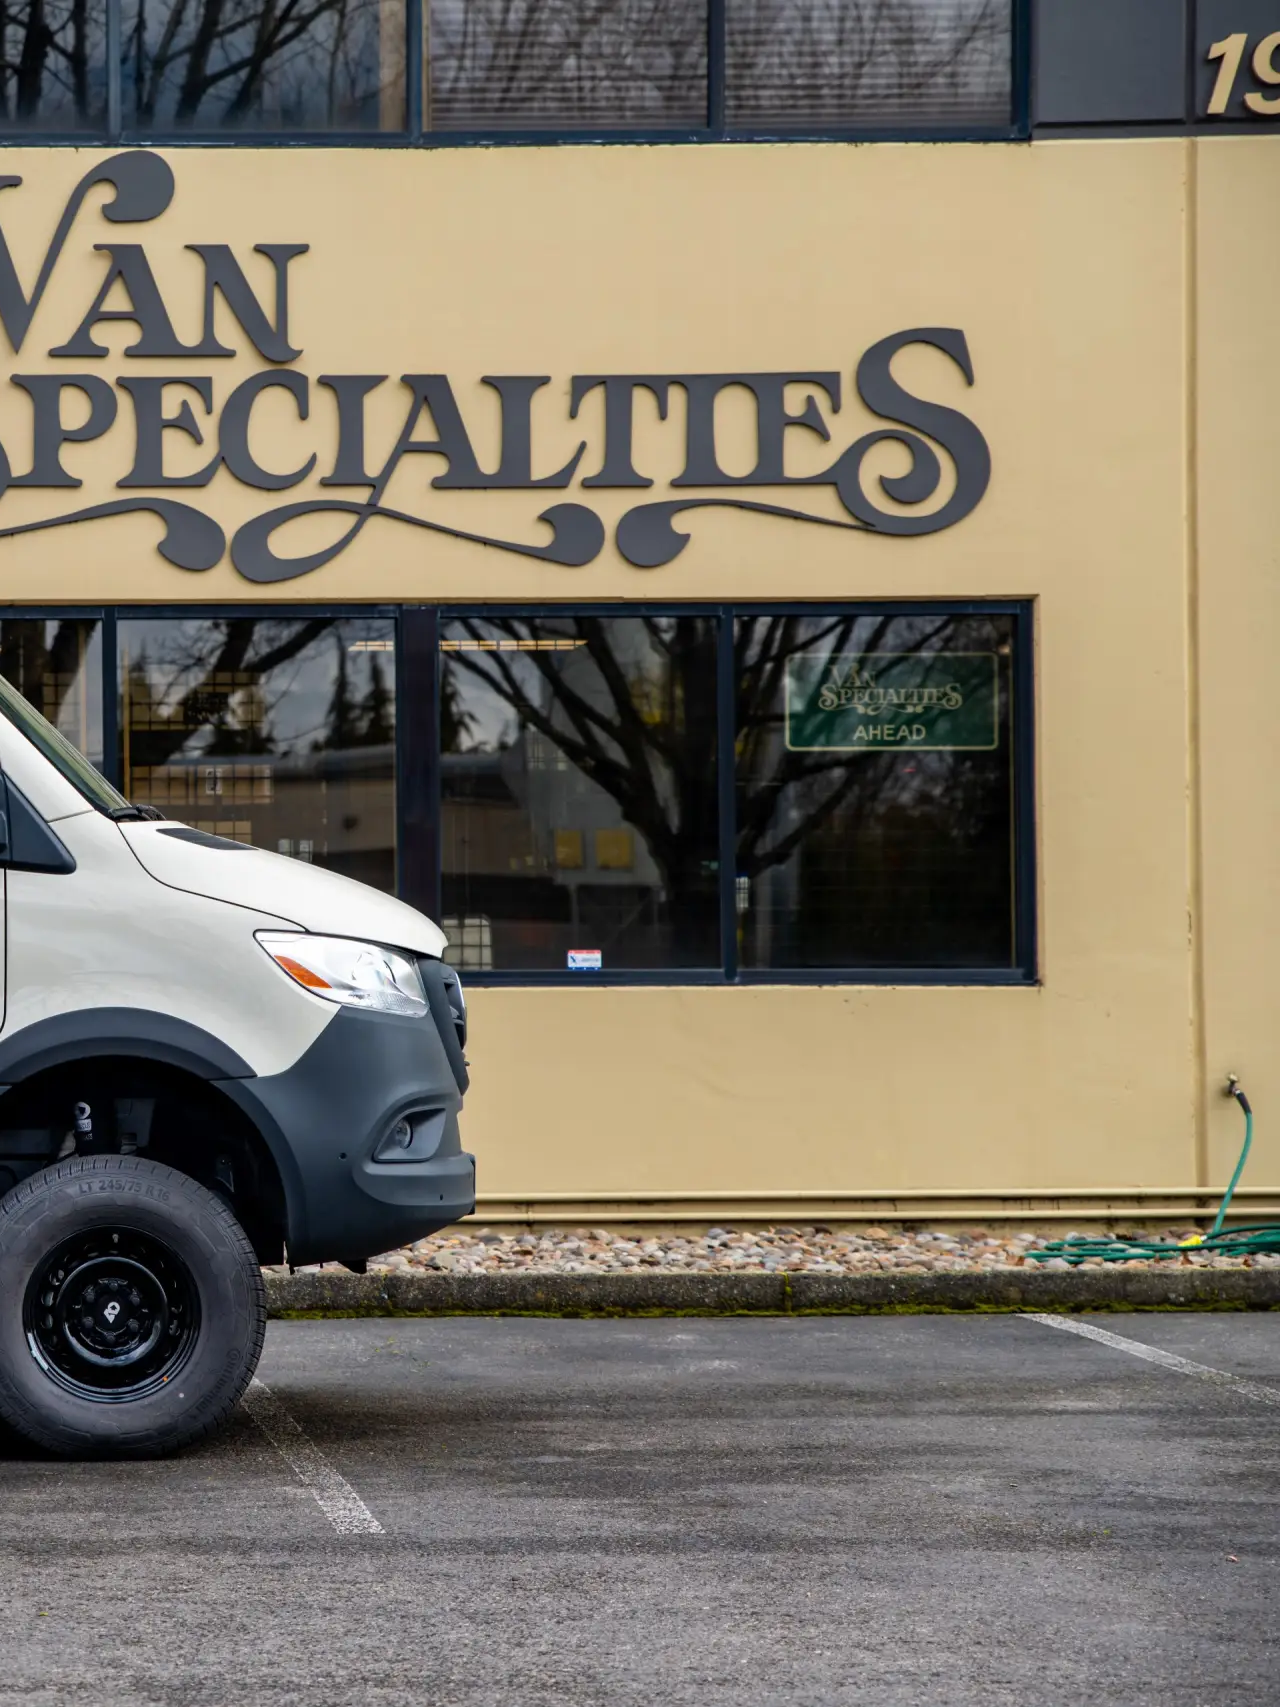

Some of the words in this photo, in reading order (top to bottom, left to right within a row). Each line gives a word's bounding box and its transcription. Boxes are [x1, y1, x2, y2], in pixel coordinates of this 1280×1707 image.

[818, 683, 963, 715] SPECIALTIES
[853, 725, 927, 741] AHEAD
[78, 1181, 93, 1194] LT
[98, 1180, 142, 1194] 245/75
[145, 1184, 155, 1197] R
[157, 1187, 171, 1201] 16
